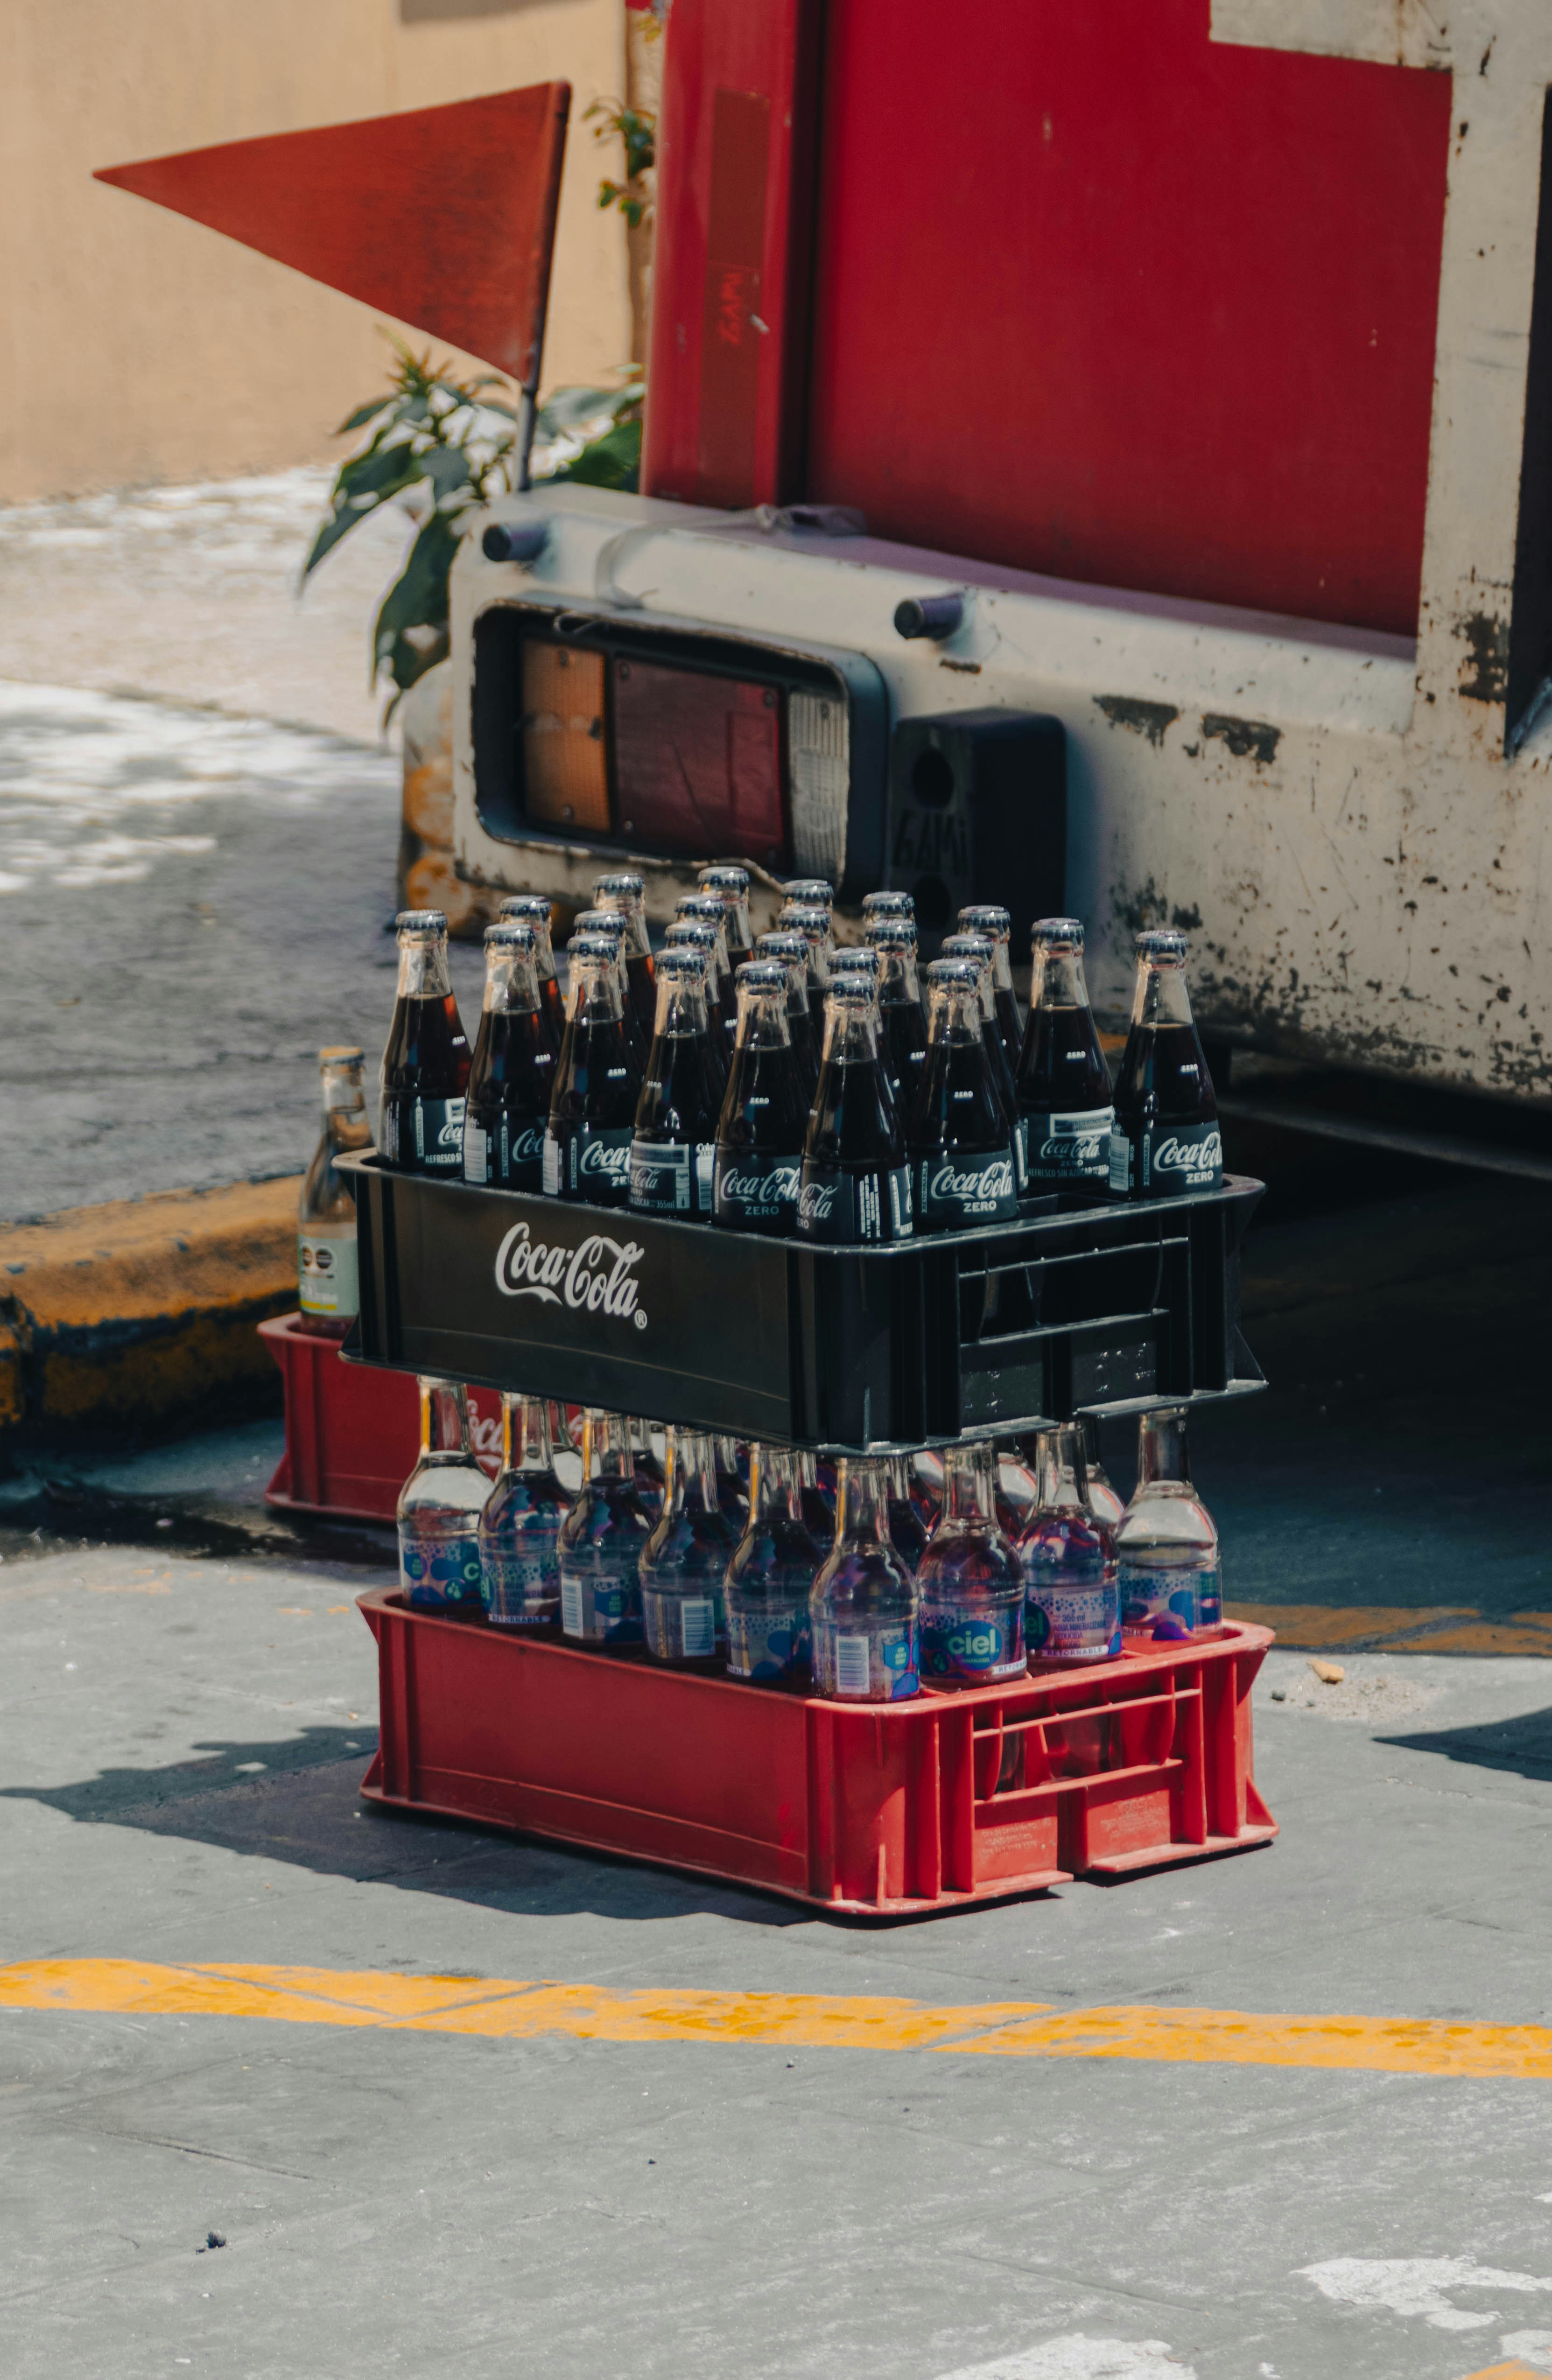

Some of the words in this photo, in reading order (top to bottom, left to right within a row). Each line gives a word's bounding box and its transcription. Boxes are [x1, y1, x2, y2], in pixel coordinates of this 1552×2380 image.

[1067, 1051, 1086, 1059] ZERO
[608, 1068, 626, 1077] ZERO
[1180, 1064, 1198, 1072] ZERO
[1040, 1134, 1101, 1158] Coca-Cola
[425, 1153, 455, 1163] REFRESCO
[1028, 1168, 1056, 1177] REFRESCO
[1057, 1168, 1067, 1176] SIN
[1186, 1170, 1214, 1185] ZERO
[931, 1159, 1013, 1200] Coca-Cola
[657, 1199, 675, 1209] 355ml
[963, 1200, 997, 1213] ZERO
[745, 1206, 780, 1216] ZERO
[496, 1222, 645, 1317] Coca-Cola
[1047, 1646, 1102, 1656] RETORNABLE
